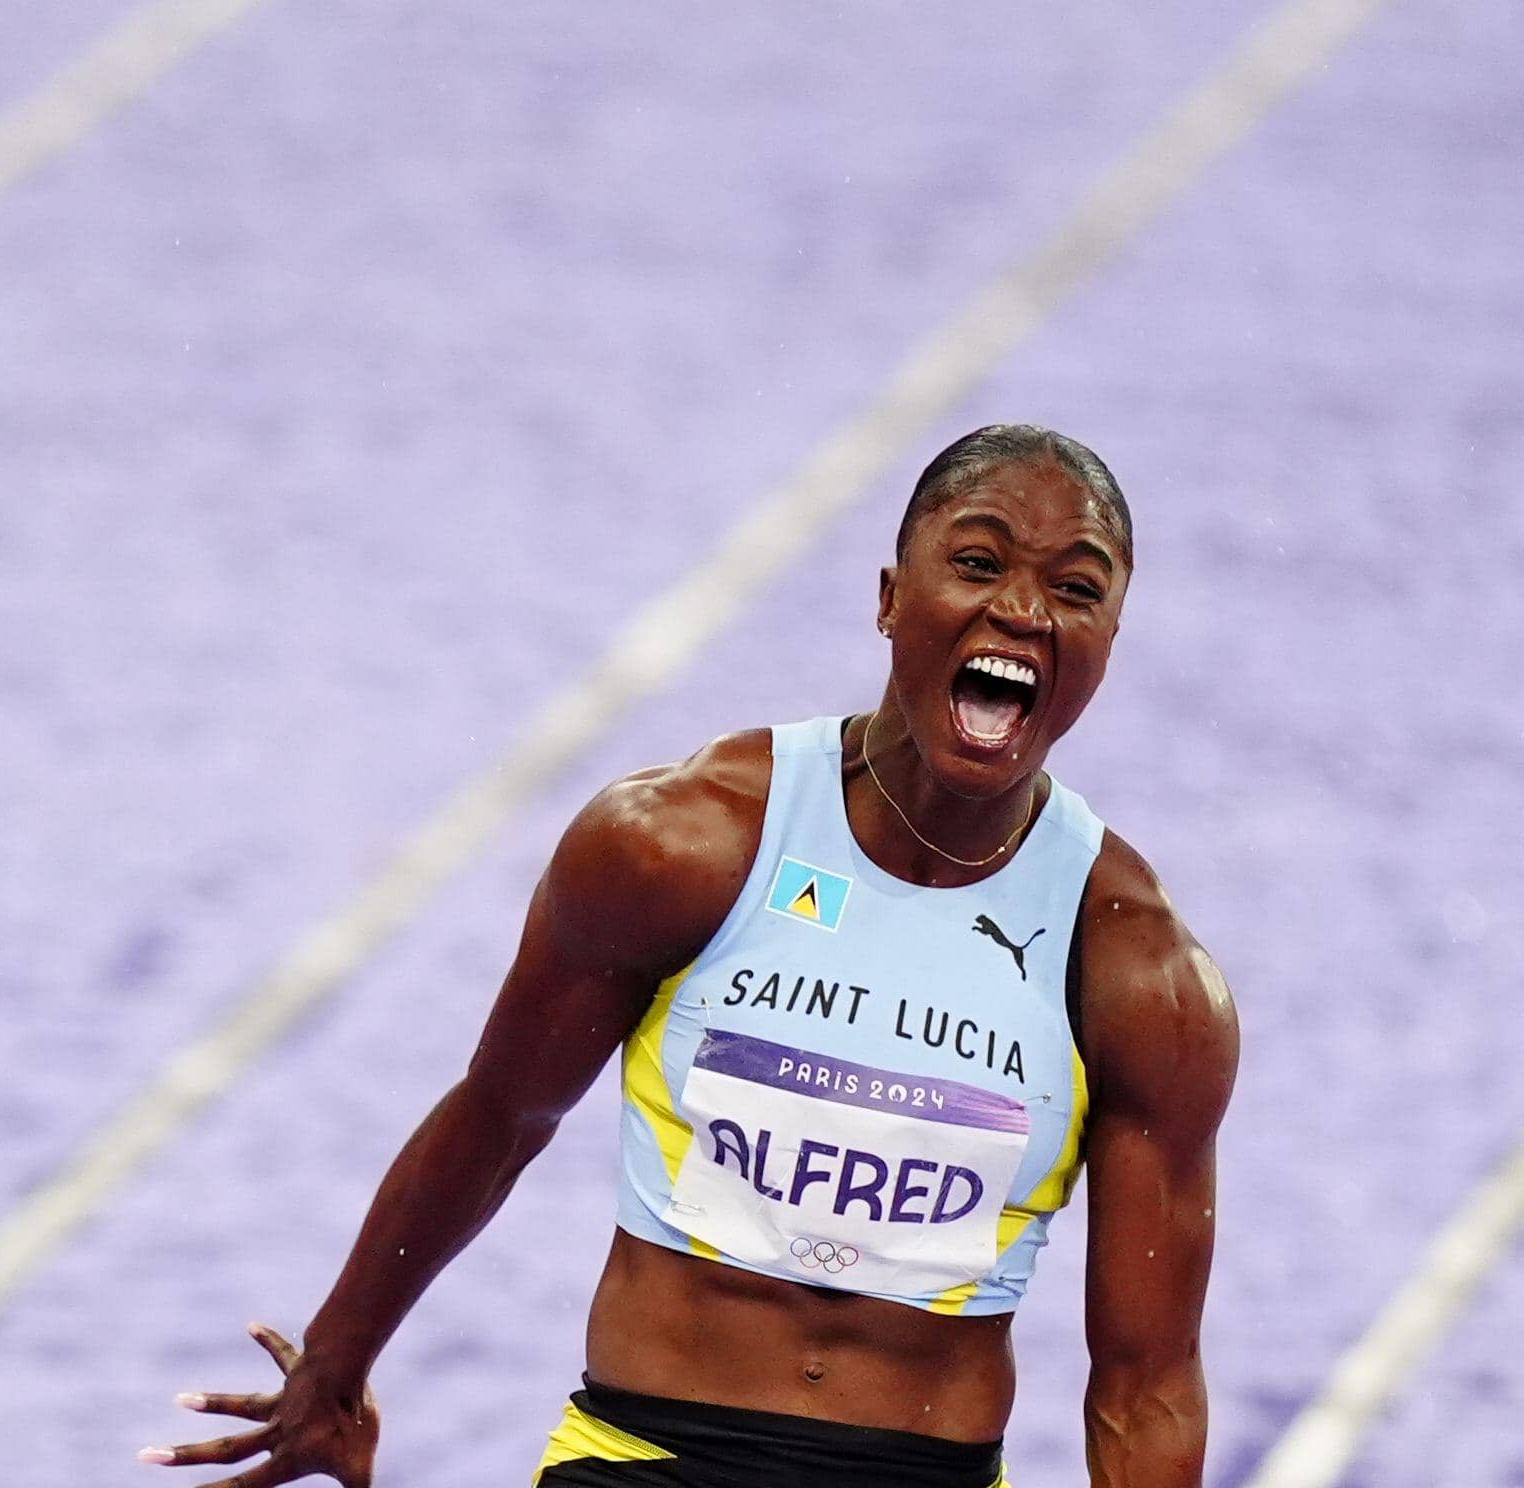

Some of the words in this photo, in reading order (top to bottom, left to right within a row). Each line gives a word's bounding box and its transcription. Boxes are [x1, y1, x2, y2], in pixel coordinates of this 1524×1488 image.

[723, 969, 870, 1025] SAINT
[895, 999, 1026, 1085] LUCIA
[778, 1057, 860, 1096] PARIS
[869, 1080, 946, 1111] 2024
[708, 1119, 985, 1225] ALFRED
